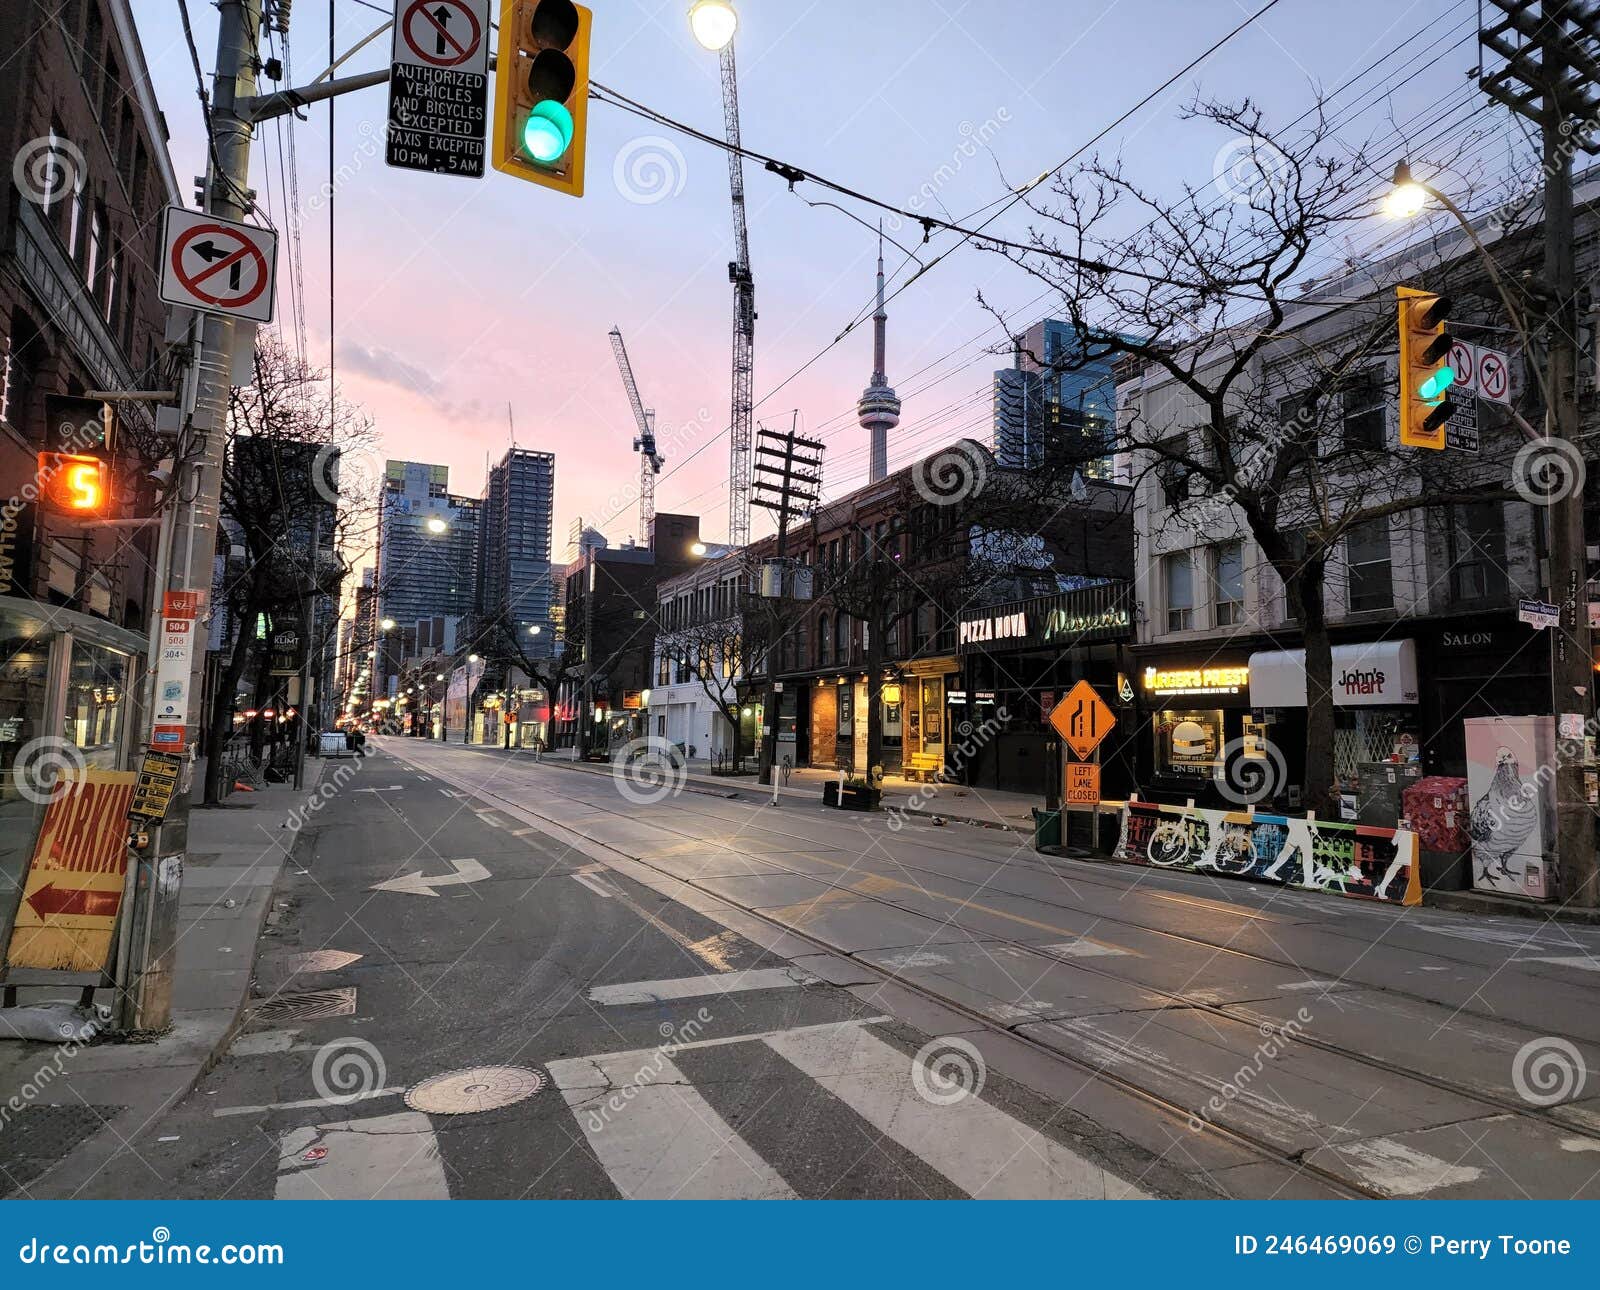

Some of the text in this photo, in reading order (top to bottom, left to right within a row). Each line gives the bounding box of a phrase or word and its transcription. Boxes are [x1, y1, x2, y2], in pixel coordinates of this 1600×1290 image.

[396, 65, 483, 89] AUTHORIZED
[406, 82, 472, 103] VEHICLES
[393, 96, 483, 120] AND BICYCLES
[402, 114, 472, 135] EXCEPTED
[390, 130, 483, 156] TAXIS EXCEPTED
[393, 148, 408, 162] 10
[410, 152, 428, 165] PM
[449, 156, 456, 168] 5
[459, 158, 478, 171] AM
[69, 465, 97, 509] 5
[169, 622, 185, 631] 504
[960, 612, 1026, 645] PIZZA NOVA
[165, 650, 180, 658] 304
[1345, 680, 1383, 695] mart
[1074, 766, 1091, 776] LEFT
[1173, 765, 1207, 774] ON SITE
[1073, 777, 1093, 788] LANE
[1068, 790, 1097, 800] CLOSED
